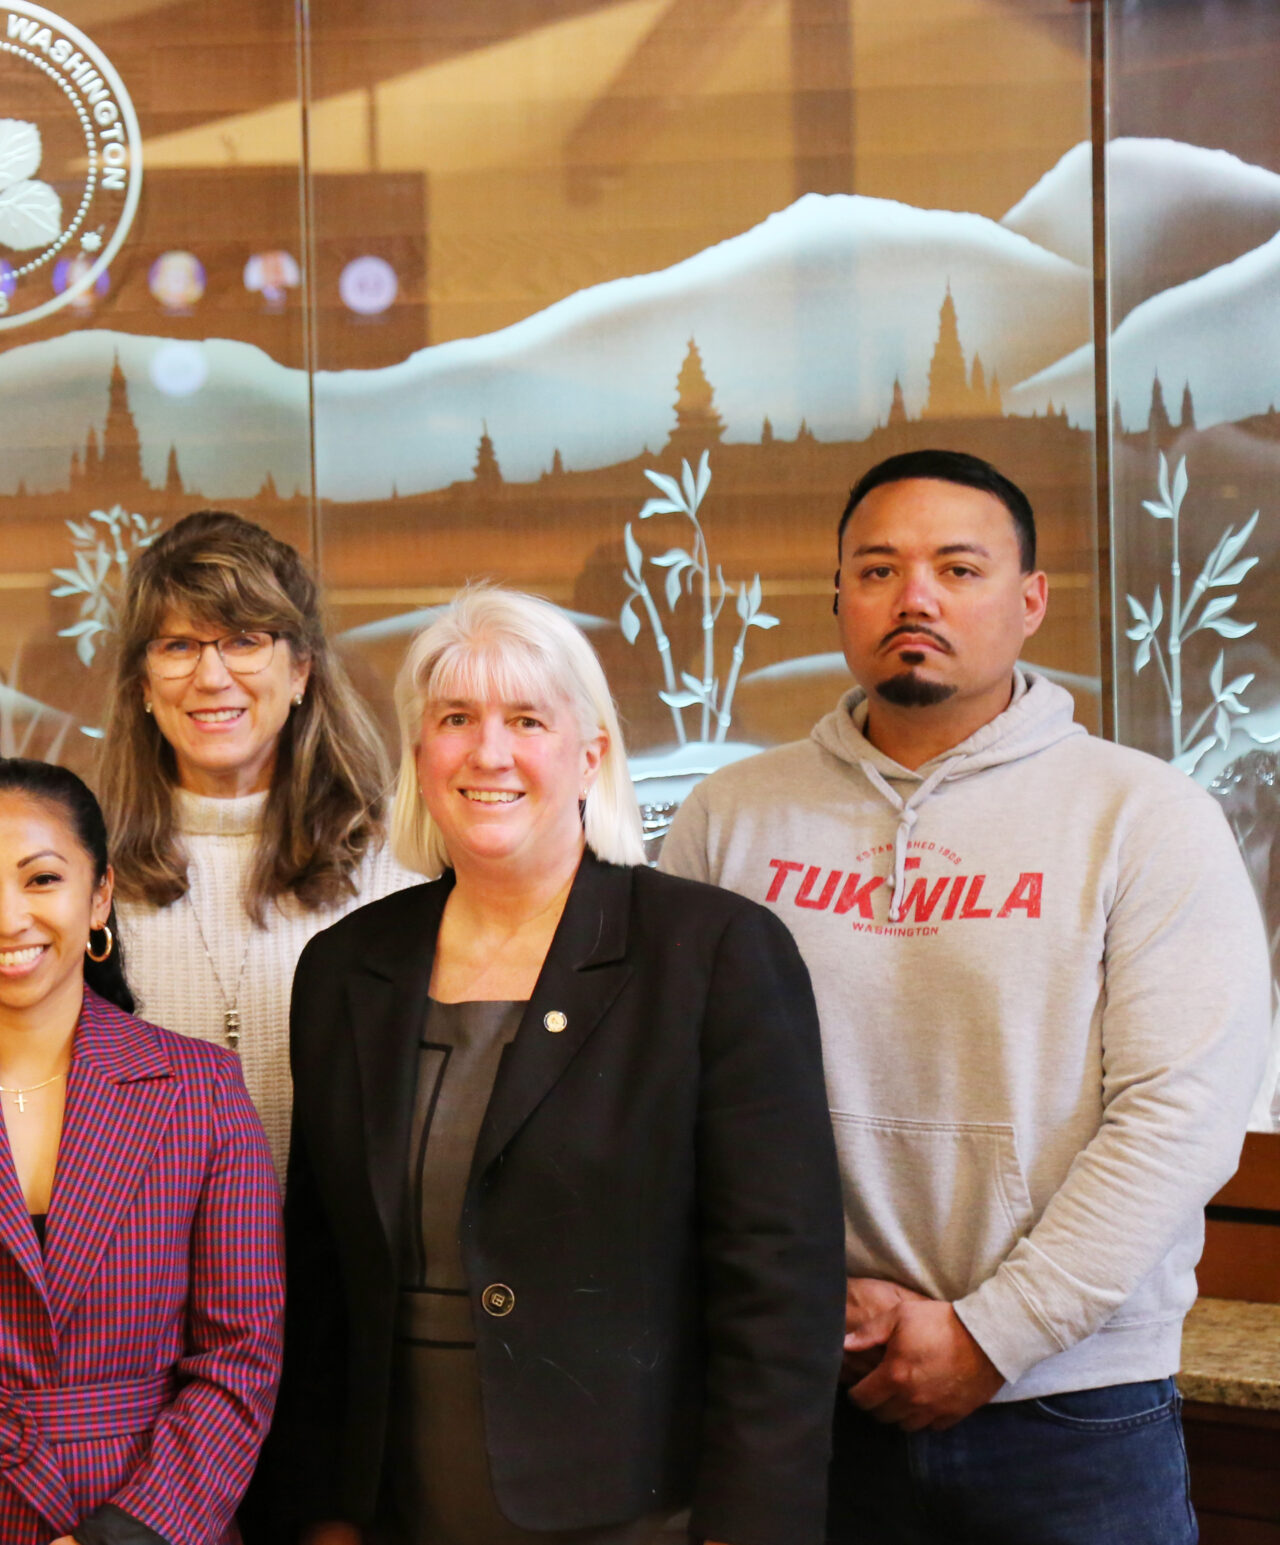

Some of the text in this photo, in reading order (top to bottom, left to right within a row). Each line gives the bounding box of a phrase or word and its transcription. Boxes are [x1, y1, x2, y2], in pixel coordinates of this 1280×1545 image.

[8, 14, 127, 190] WASHINGTON
[856, 841, 936, 862] ESTABSHED
[765, 858, 1043, 923] TUKWILA
[852, 921, 939, 937] WASHINGTON
